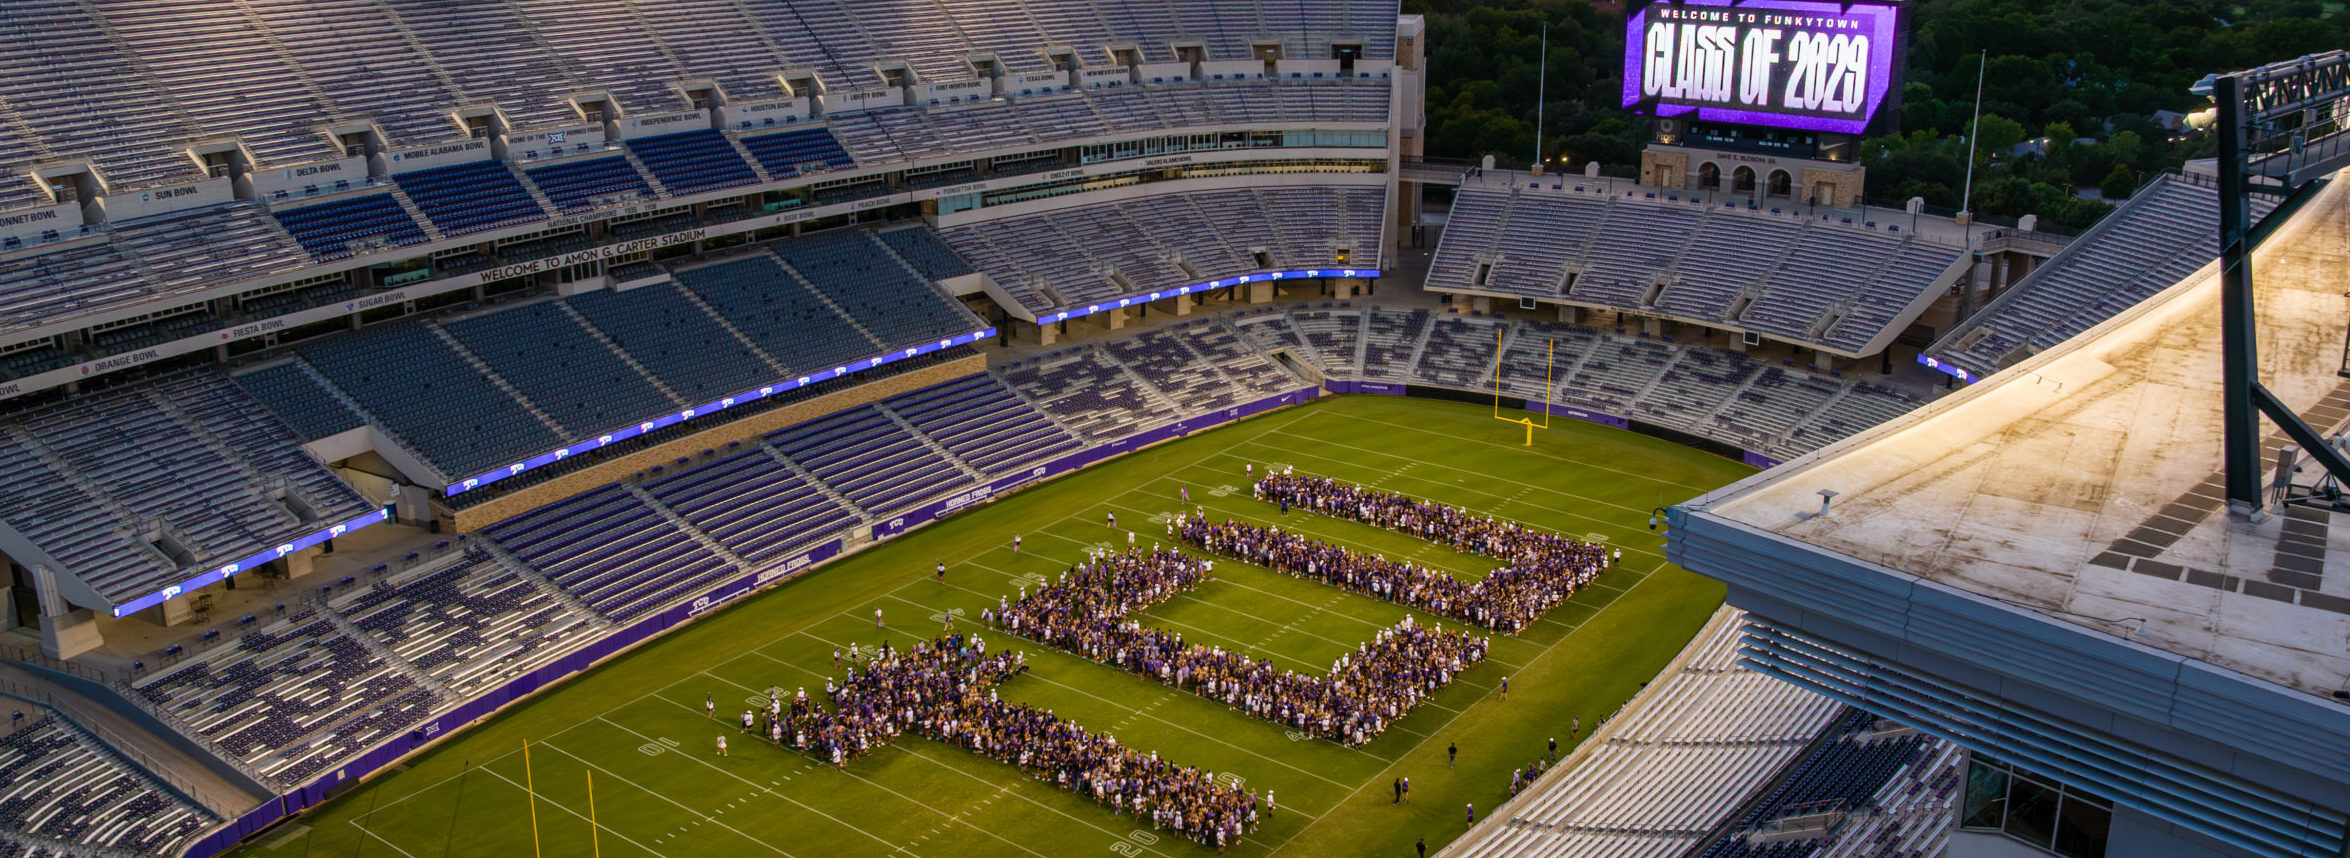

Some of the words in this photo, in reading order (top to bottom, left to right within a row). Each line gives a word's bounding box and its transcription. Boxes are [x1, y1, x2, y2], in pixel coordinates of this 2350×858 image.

[1661, 8, 1729, 22] WELCOME
[1738, 13, 1755, 23] TO
[1765, 14, 1859, 30] FUNKYTOWN
[1116, 67, 1129, 75] BOWL
[1644, 22, 1737, 103] CLASS
[1740, 28, 1782, 106] OF
[1784, 31, 1869, 113] 2029
[871, 90, 887, 98] BOWL
[936, 83, 948, 91] FORT
[949, 81, 967, 90] WORTH
[967, 80, 982, 89] BOWL
[751, 103, 776, 113] HOUSTON
[777, 101, 793, 110] BOWL
[641, 115, 684, 126] INDEPENDENCE
[684, 112, 701, 122] BOWL
[404, 149, 429, 160] MOBILE
[430, 144, 464, 157] ALABAMA
[465, 141, 485, 151] BOWL
[296, 164, 318, 177] DELTA
[319, 162, 342, 174] BOWL
[155, 189, 172, 201] SUN
[174, 186, 198, 198] BOWL
[31, 209, 57, 222] BOWL
[547, 217, 579, 228] NATIONAL
[580, 209, 617, 222] CHAMPIONS
[480, 262, 540, 282] WELCOME
[543, 257, 560, 270] TO
[564, 249, 599, 266] AMON
[602, 246, 612, 258] G.
[617, 238, 658, 254] CARTER
[662, 229, 706, 247] STADIUM
[358, 298, 383, 309] SUGAR
[384, 291, 407, 302] BOWL
[233, 326, 260, 338] FIESTA
[261, 319, 284, 331] BOWL
[95, 355, 131, 373] ORANGE
[132, 349, 159, 362] BOWL
[946, 494, 971, 508] HORNED
[971, 486, 992, 498] FROGS
[757, 564, 786, 583] HORNED
[787, 554, 810, 571] FROGS
[692, 597, 710, 610] TCU
[638, 737, 681, 756] 10
[1109, 829, 1160, 858] 20
